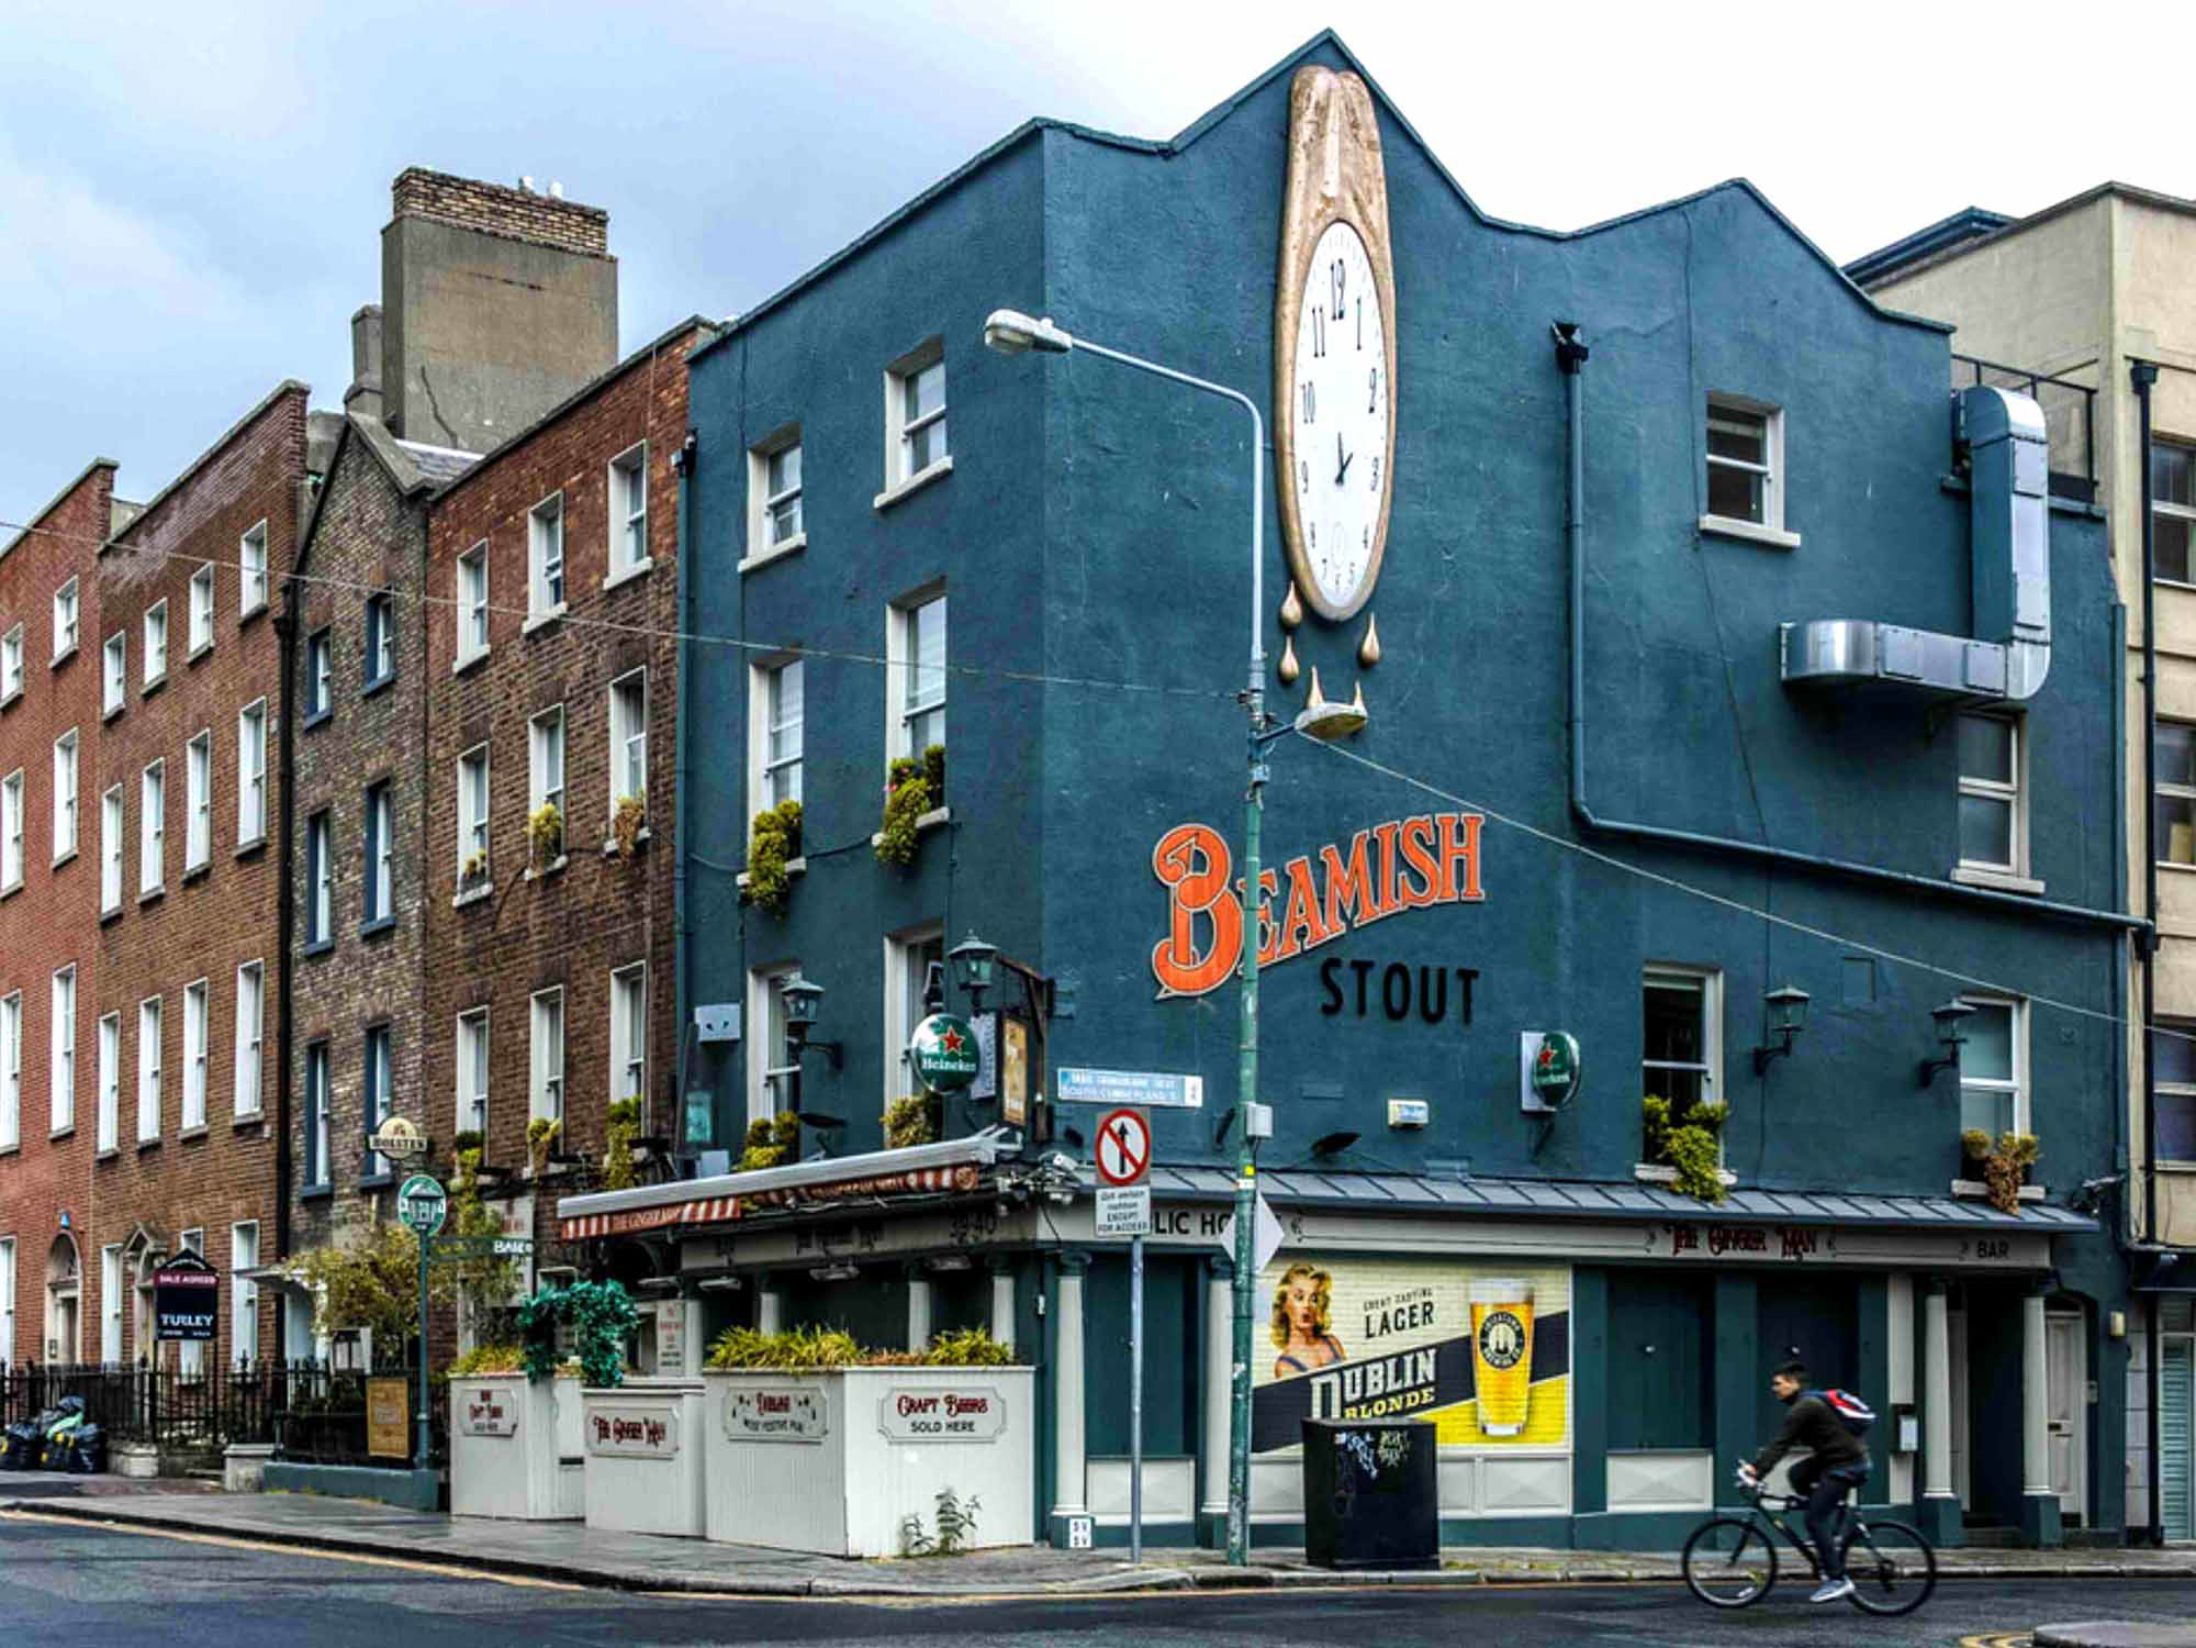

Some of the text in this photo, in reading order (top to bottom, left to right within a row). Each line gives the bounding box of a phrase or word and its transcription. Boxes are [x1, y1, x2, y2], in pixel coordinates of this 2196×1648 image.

[1330, 257, 1346, 321] 12
[1152, 812, 1486, 1000] BEAMISH
[1321, 956, 1480, 1025] STOUT
[921, 1057, 977, 1072] Heineken
[1151, 1210, 1190, 1234] LIC
[1977, 1239, 2009, 1259] BAR
[1365, 1301, 1434, 1340] LAGER
[1310, 1348, 1437, 1419] DUBLIN
[1344, 1387, 1436, 1418] BLONDE
[911, 1420, 975, 1433] SOLD HERE
